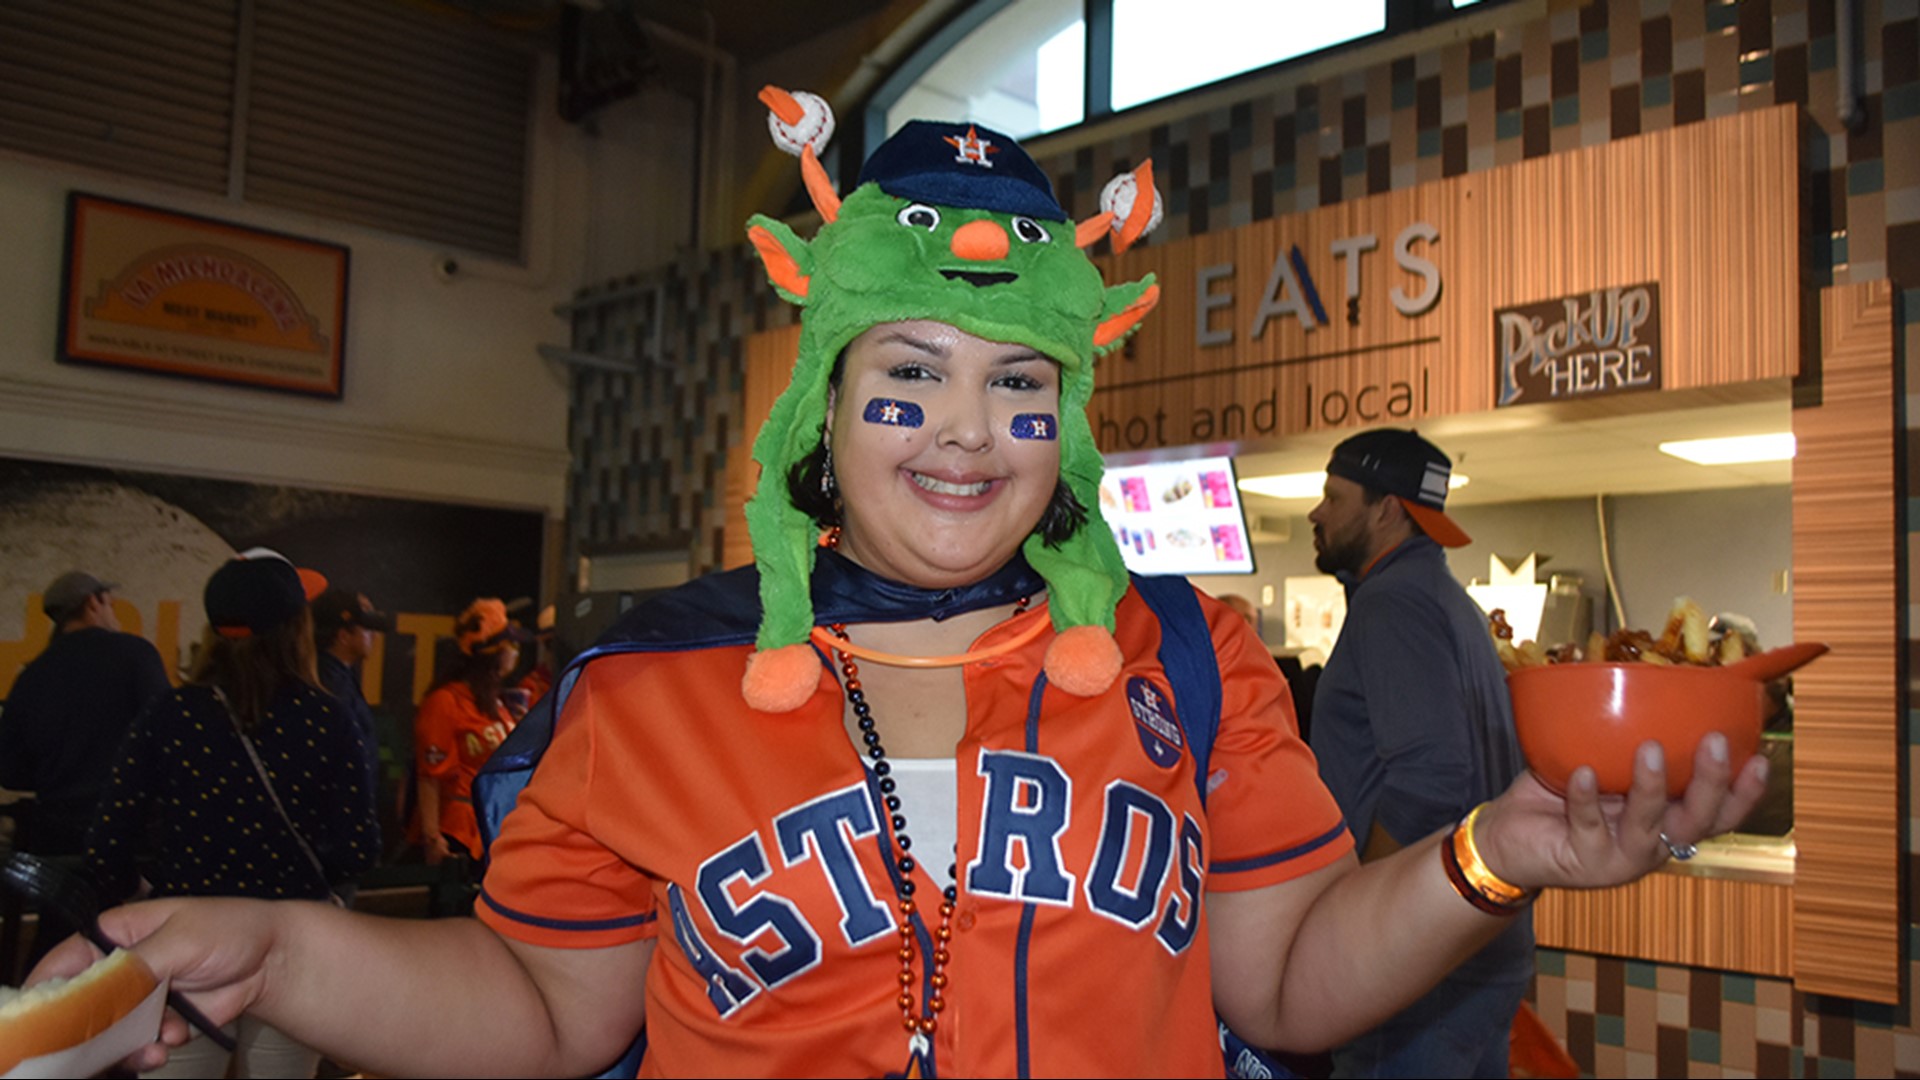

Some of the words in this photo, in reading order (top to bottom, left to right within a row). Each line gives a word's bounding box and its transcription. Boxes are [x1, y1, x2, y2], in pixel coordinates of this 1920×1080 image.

[954, 136, 992, 167] H
[1196, 222, 1443, 347] EATS
[1544, 345, 1651, 397] HERE
[1099, 407, 1168, 449] hot
[1191, 388, 1277, 442] and
[1306, 366, 1429, 428] local
[1129, 696, 1182, 746] STRONG
